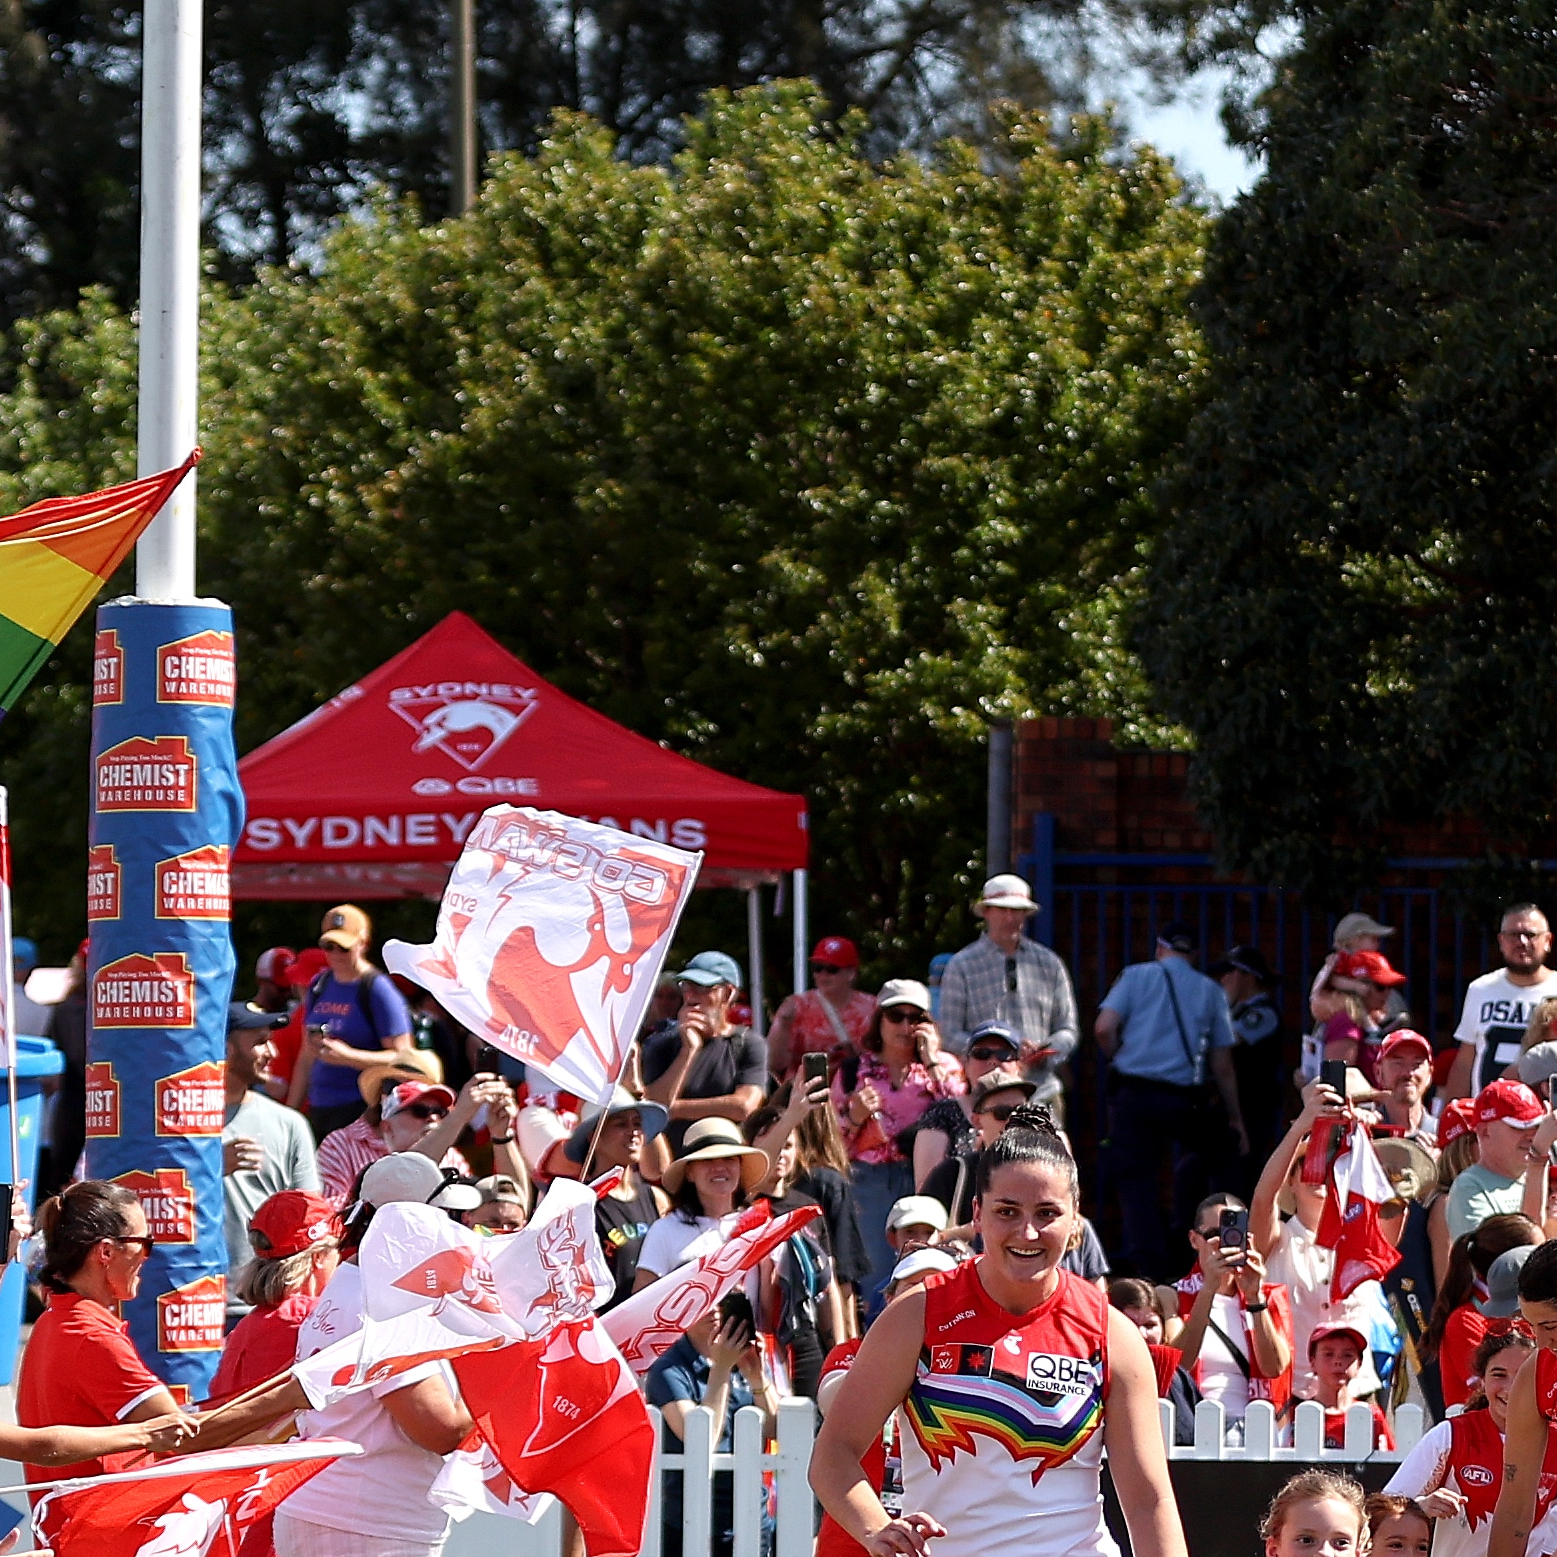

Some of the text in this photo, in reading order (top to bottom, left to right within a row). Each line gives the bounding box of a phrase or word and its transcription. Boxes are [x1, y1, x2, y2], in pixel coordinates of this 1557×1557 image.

[389, 682, 538, 699] SYDNEY
[100, 764, 189, 787] CHEMIST
[100, 790, 185, 802] WAREHOUSE
[455, 776, 539, 796] QBE
[246, 813, 477, 850] SYDNEY
[97, 981, 187, 1004] CHEMIST
[96, 1005, 185, 1018] WAREHOUSE
[1031, 1354, 1092, 1385] QBE
[1028, 1379, 1087, 1396] INSURANCE
[552, 1394, 581, 1420] 1874
[1463, 1469, 1491, 1483] AFL
